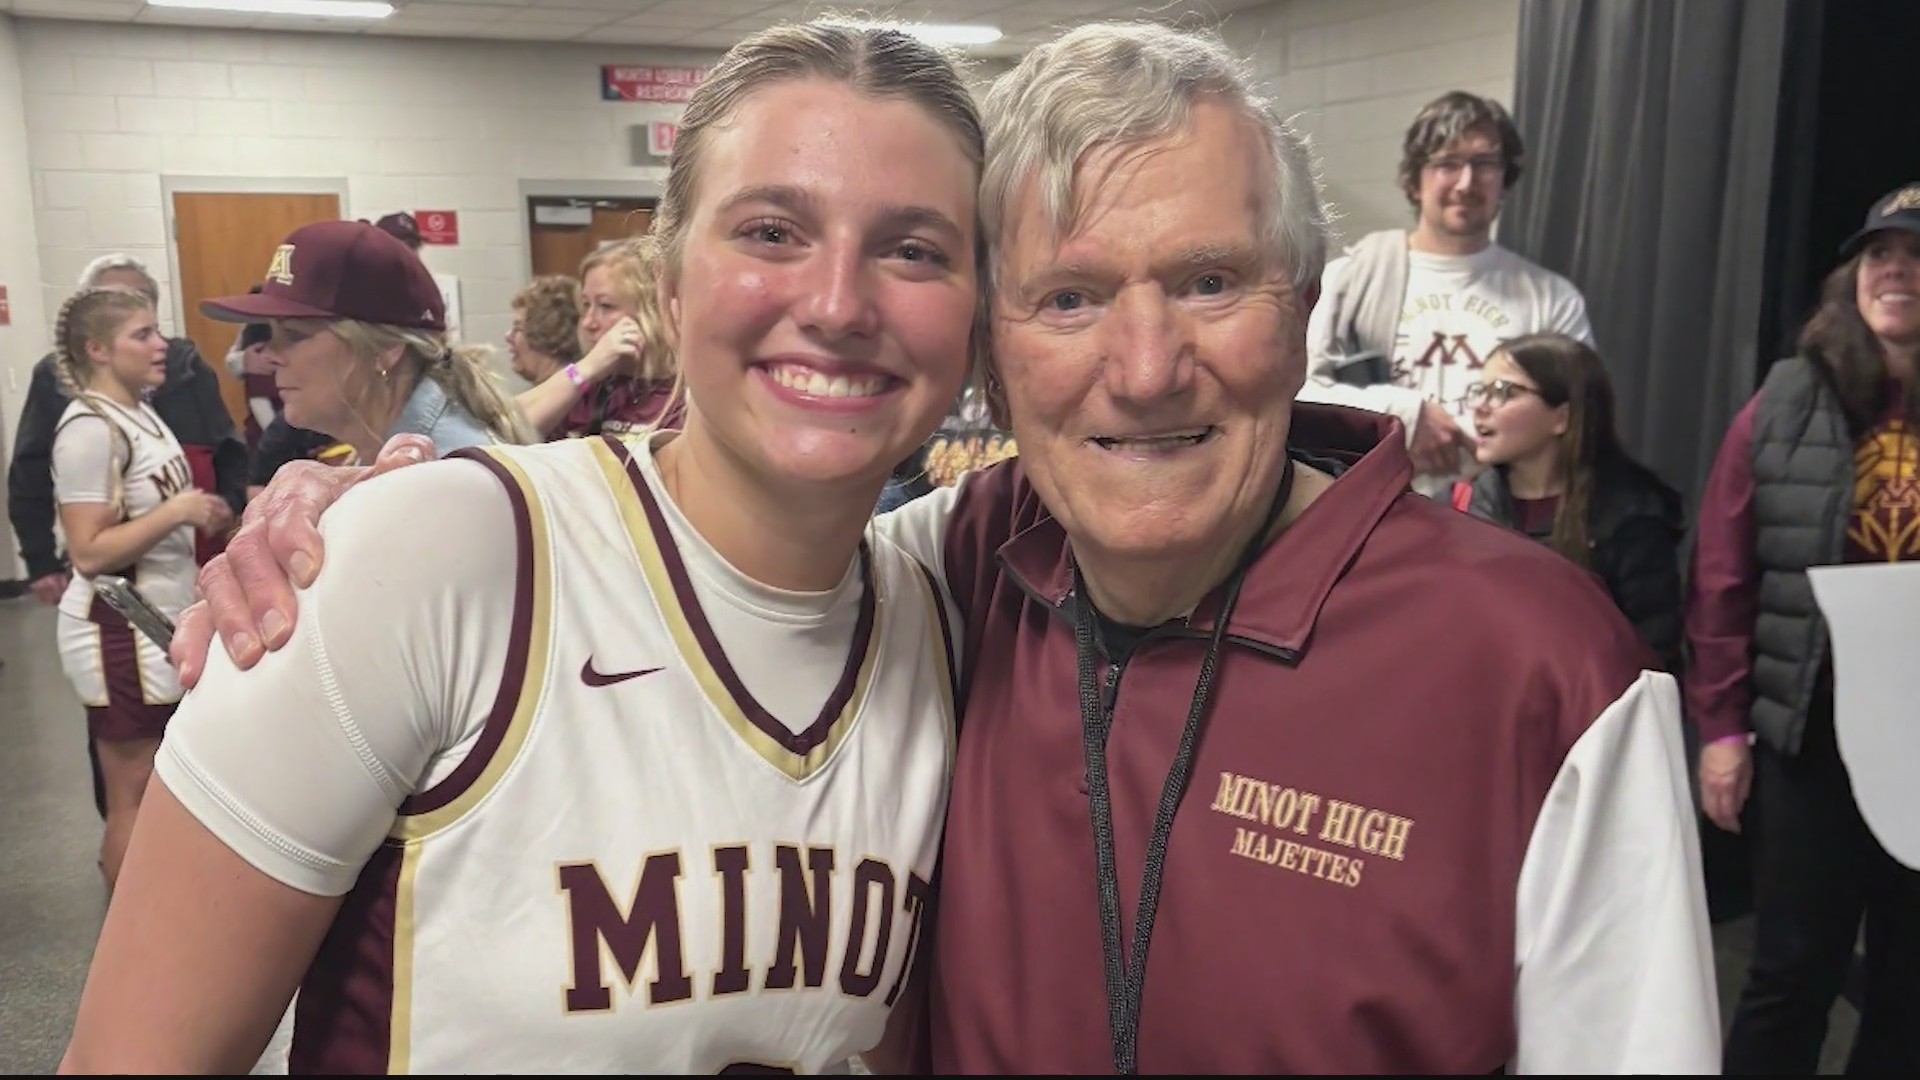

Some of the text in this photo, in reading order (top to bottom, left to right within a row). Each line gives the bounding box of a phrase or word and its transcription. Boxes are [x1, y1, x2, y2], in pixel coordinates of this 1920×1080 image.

[1210, 771, 1415, 861] MINOT HIGH
[1230, 827, 1364, 888] MAJETTES
[554, 841, 934, 1016] MINOT
